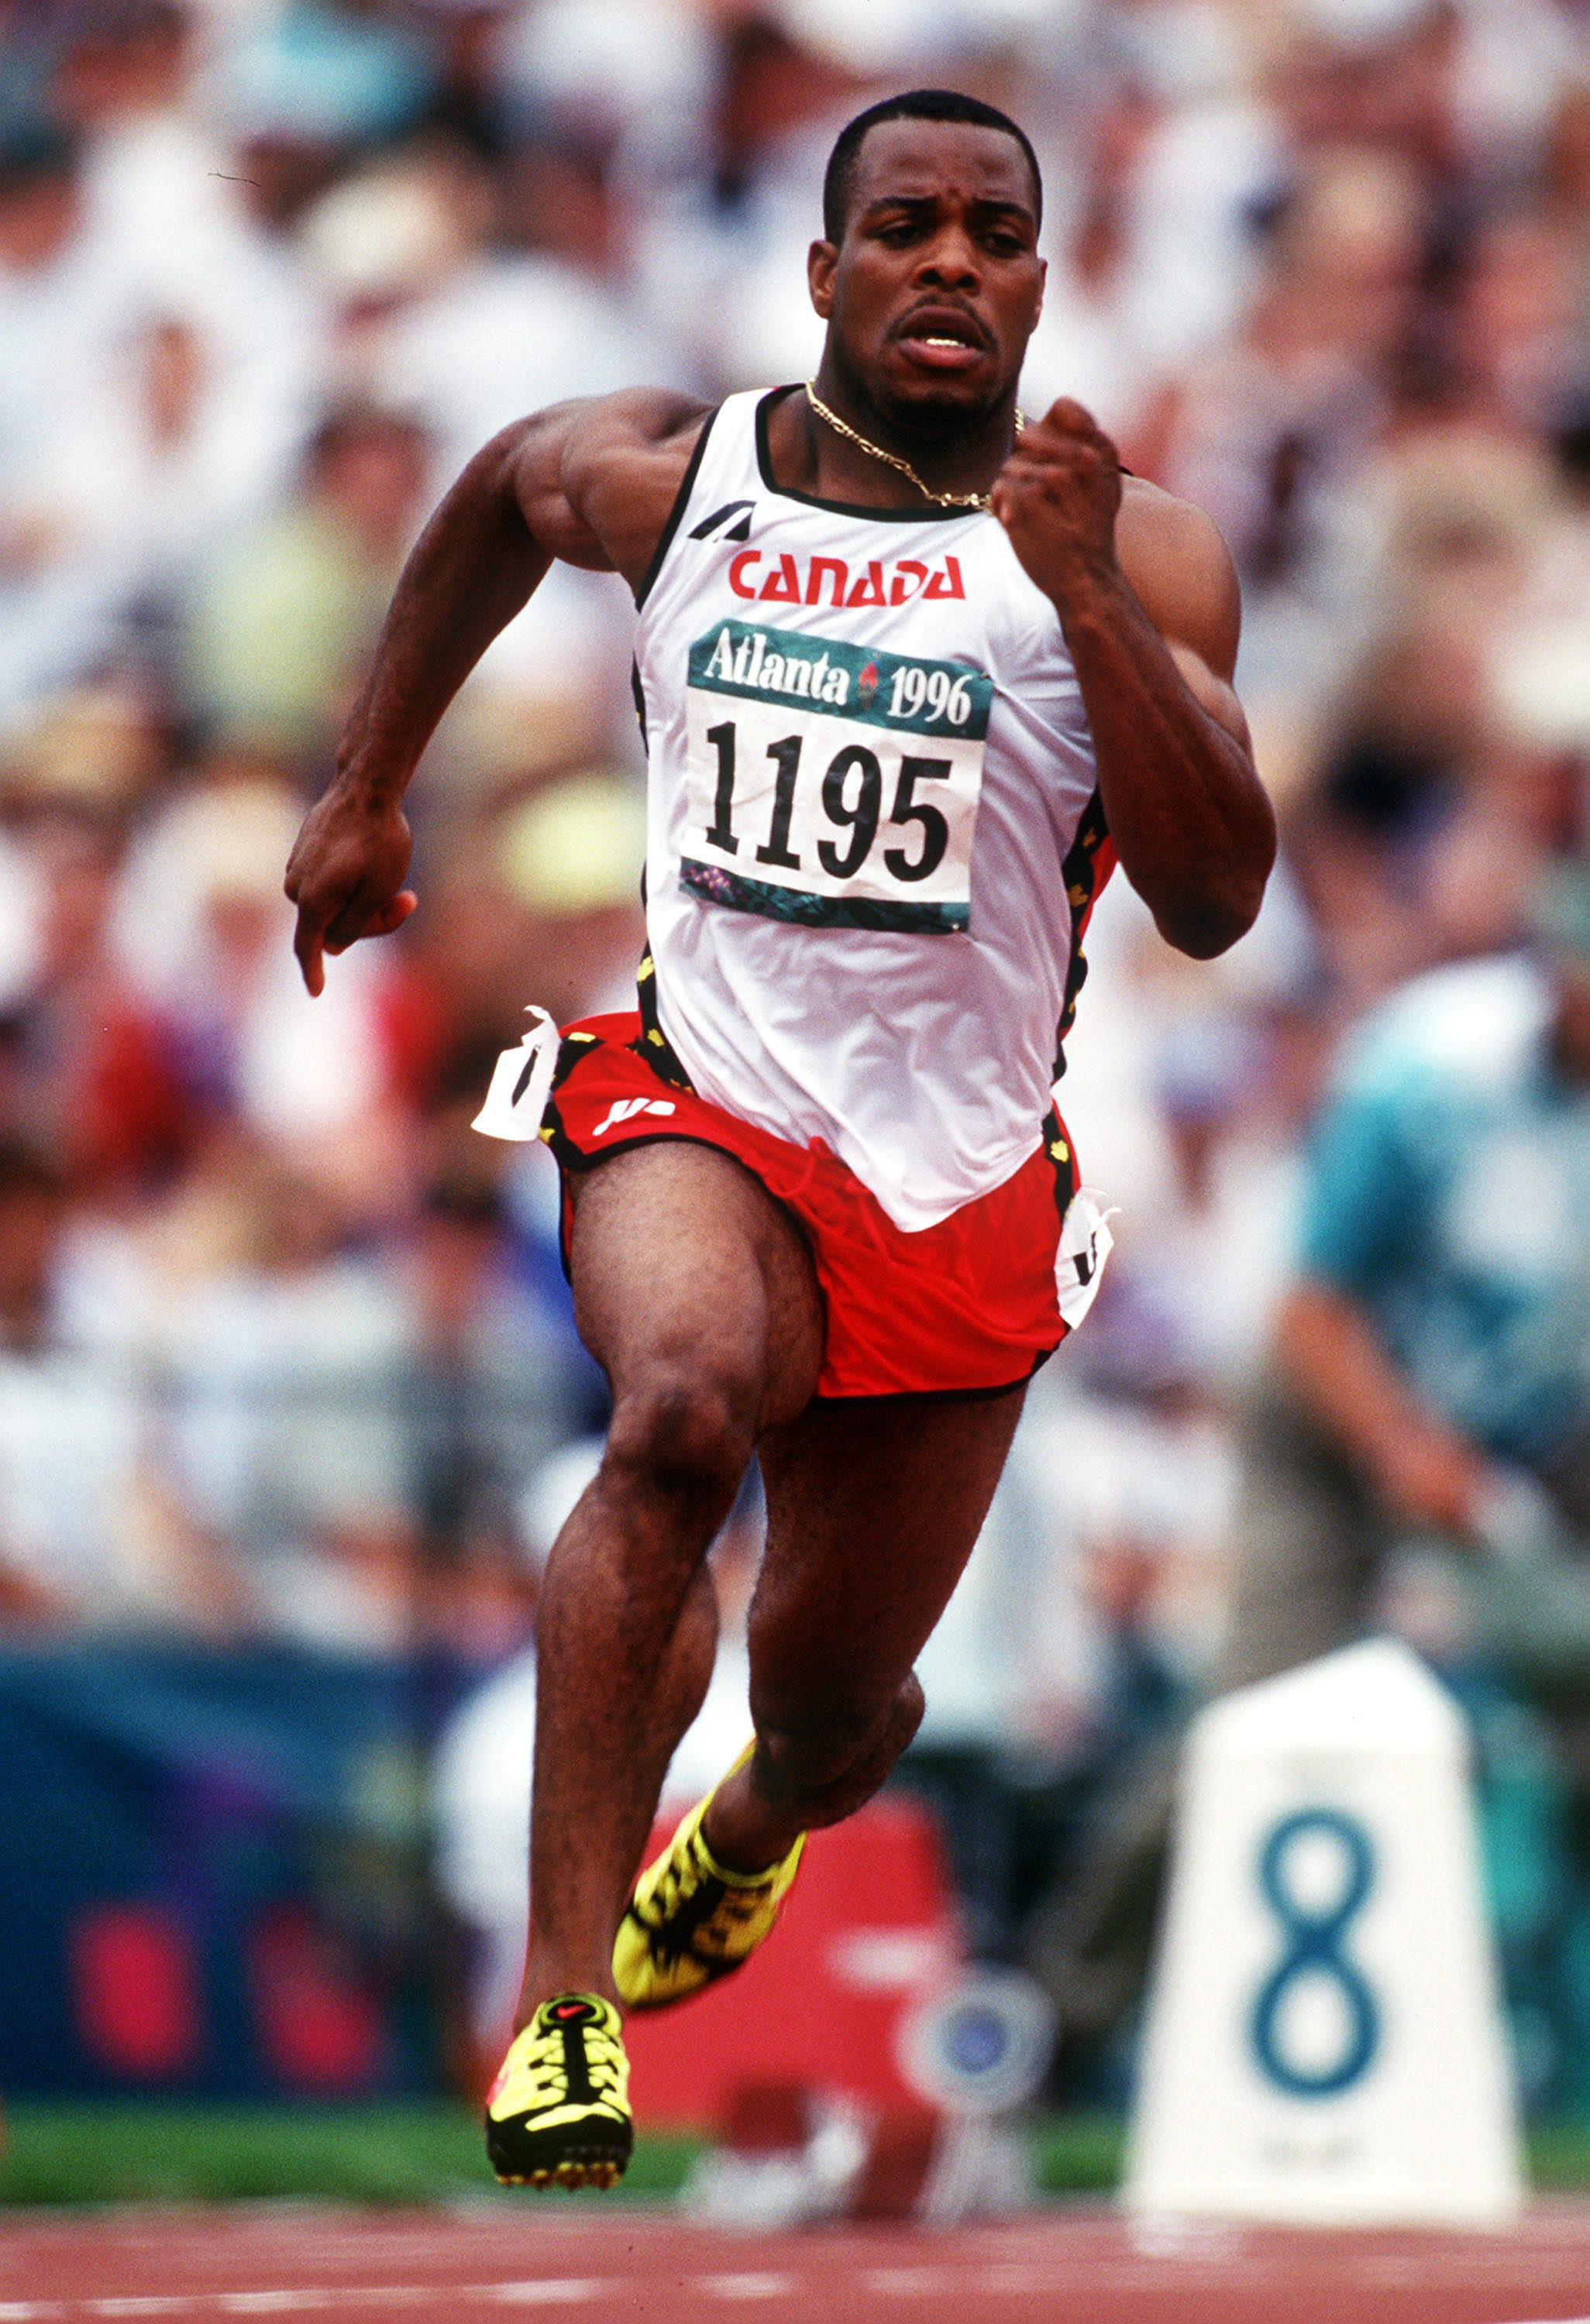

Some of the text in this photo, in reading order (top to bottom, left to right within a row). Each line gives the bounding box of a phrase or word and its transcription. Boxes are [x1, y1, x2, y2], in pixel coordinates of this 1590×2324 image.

[728, 549, 966, 608] CANADA
[704, 627, 972, 726] Atlanta 1996
[705, 720, 953, 883] 1195
[1252, 1807, 1381, 2097] 8
